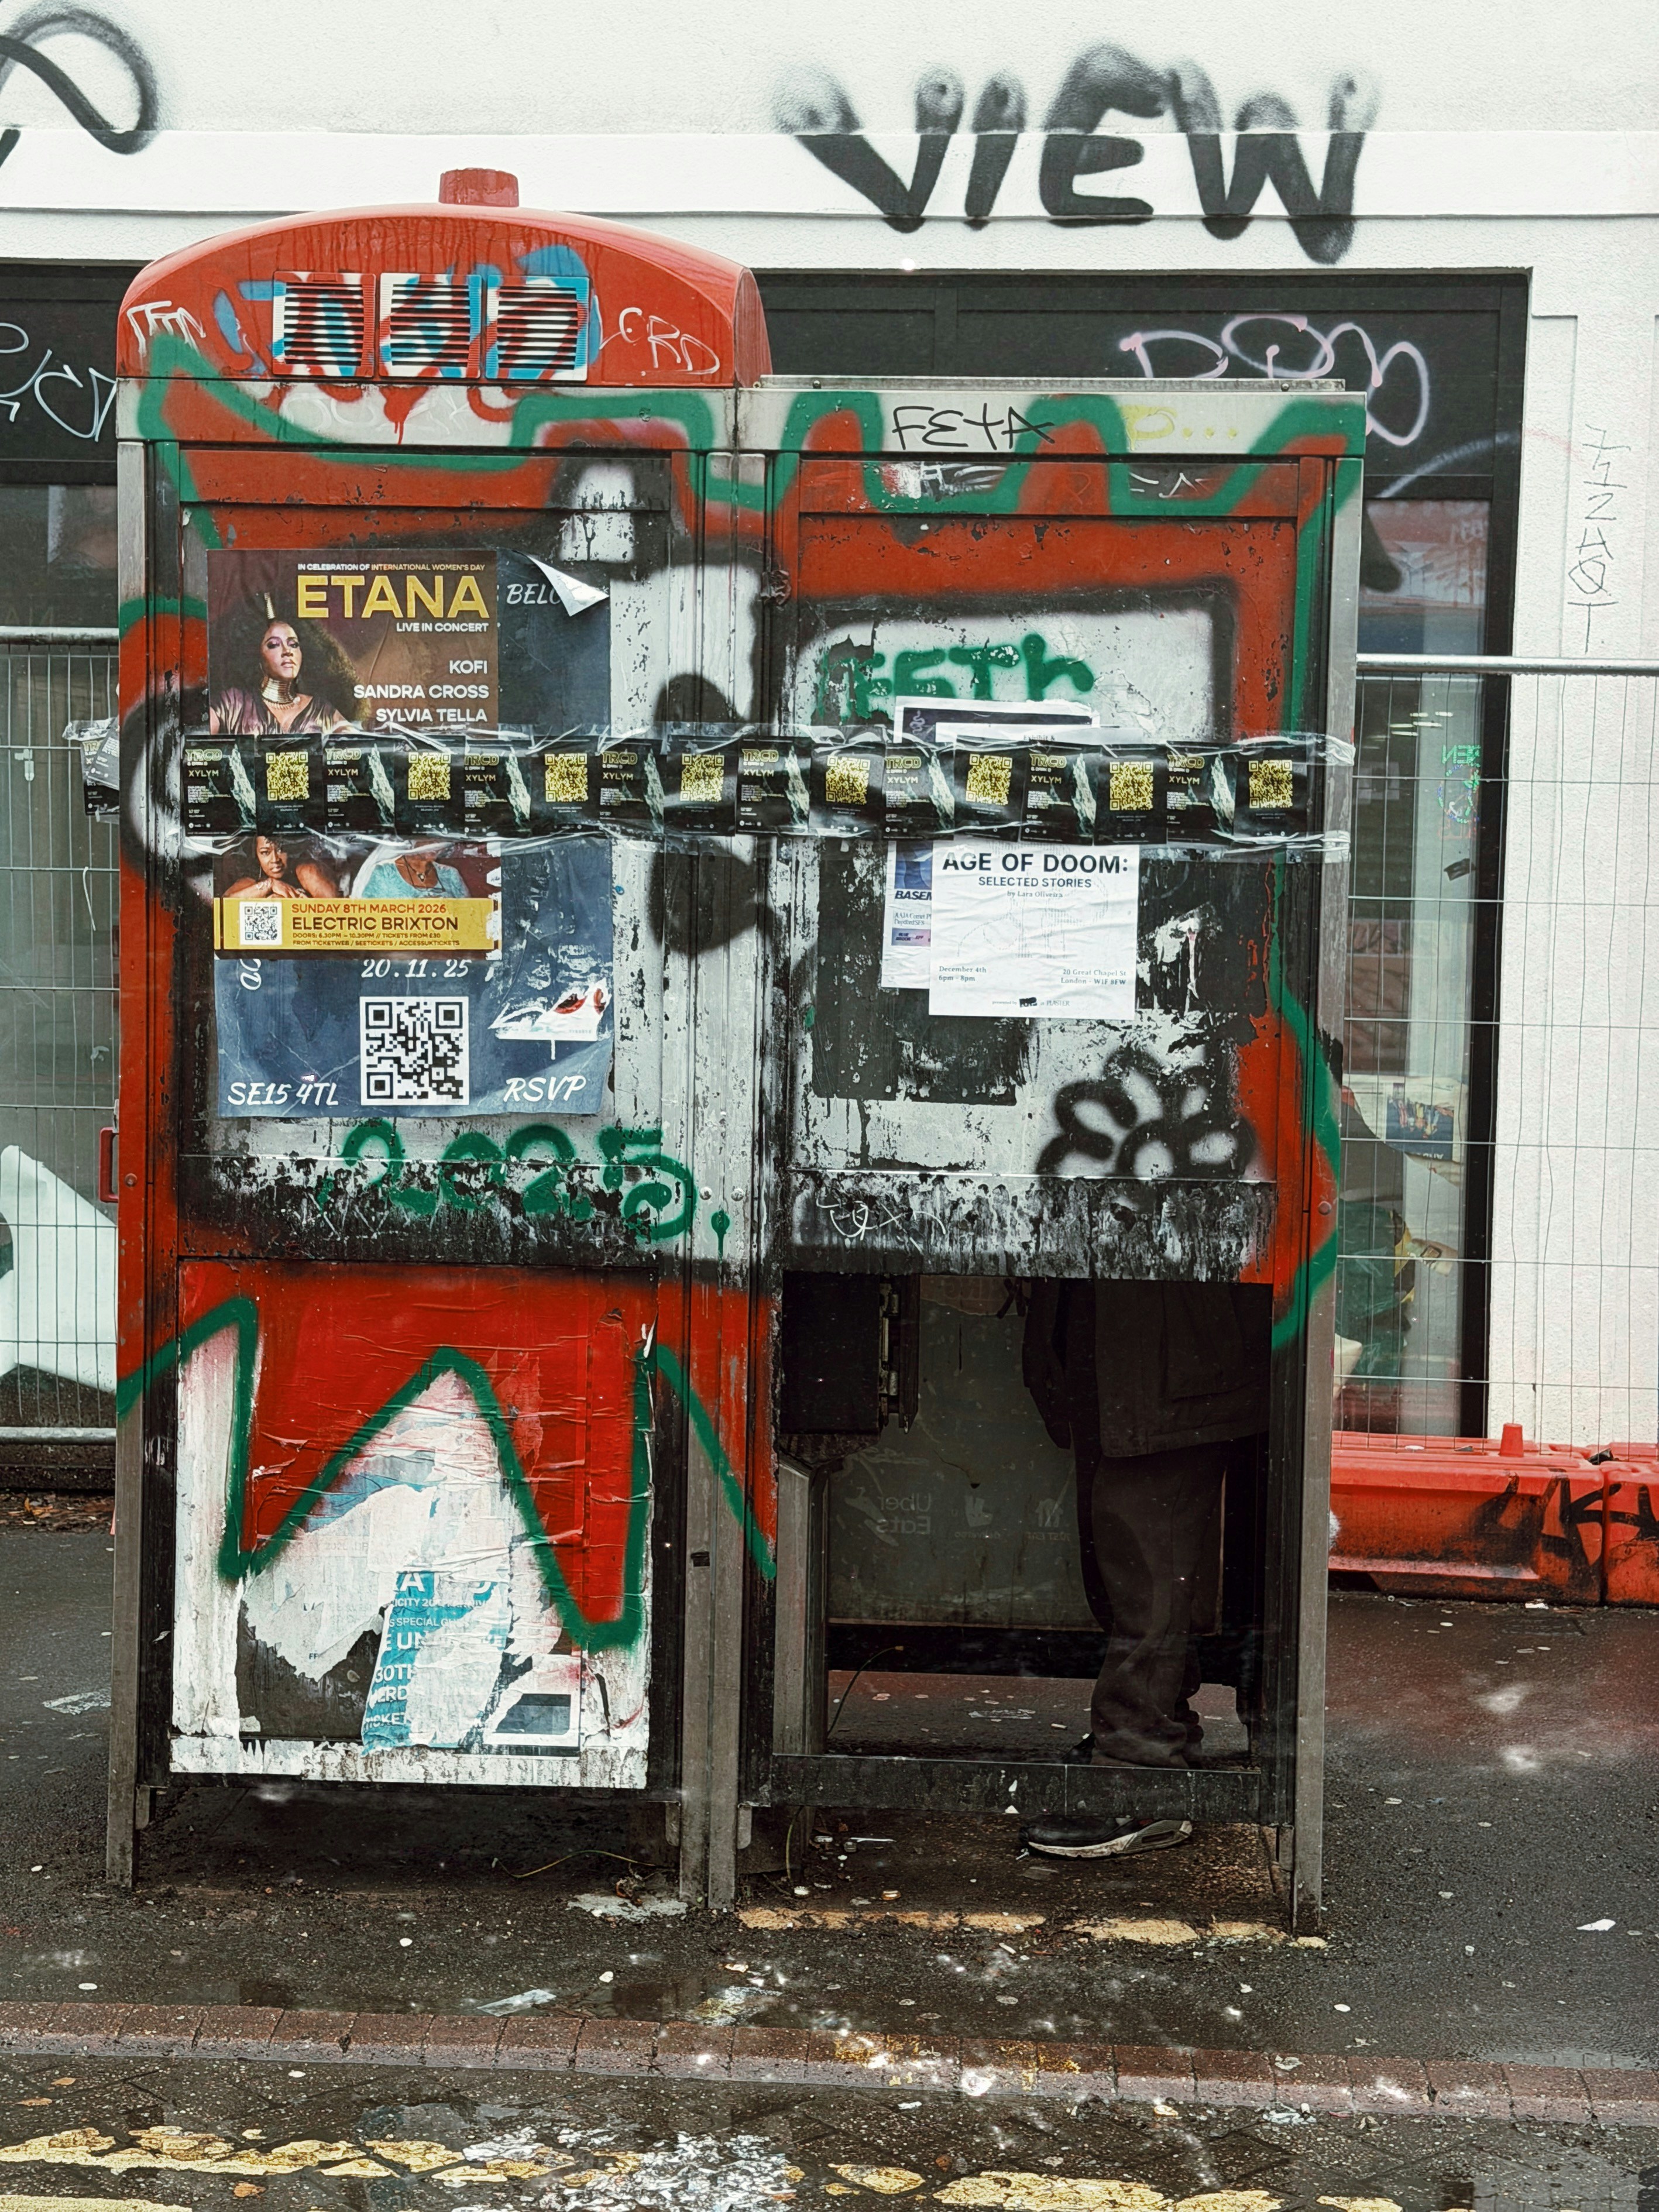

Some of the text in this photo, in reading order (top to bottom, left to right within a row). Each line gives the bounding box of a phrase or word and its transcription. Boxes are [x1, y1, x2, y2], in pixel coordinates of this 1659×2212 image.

[775, 43, 1378, 266] VIEW
[297, 563, 486, 572] IN CELEBRATION OF INTERNATIONAL WOMEN'S DAY
[297, 575, 490, 619] ETANA
[396, 622, 489, 633] LIVE IN CONCERT
[449, 660, 488, 675] KOFI
[353, 684, 490, 699] SANDRA CROSS
[376, 707, 488, 723] SYLVIA TELLA
[602, 751, 638, 765] TRCD
[741, 748, 779, 762] TRCD
[1029, 753, 1067, 768] TRCD
[884, 756, 922, 769] TRCD
[603, 772, 634, 781] XYLYM
[743, 769, 774, 777] XYLYM
[1031, 775, 1062, 784] XYLYM
[1169, 775, 1200, 785] XYLYM
[942, 851, 1128, 874] AGE OF DOOM:
[978, 877, 1092, 888] SELECTED STORIES
[291, 904, 446, 913] SUNDAY 8TH MARCH 2026
[292, 916, 458, 930] ELECTRIC BRIXTON
[1093, 969, 1118, 977] Chapel
[227, 1082, 339, 1106] SE15 4TL
[503, 1075, 587, 1103] RSVP
[397, 1617, 439, 1627] SPECIAL
